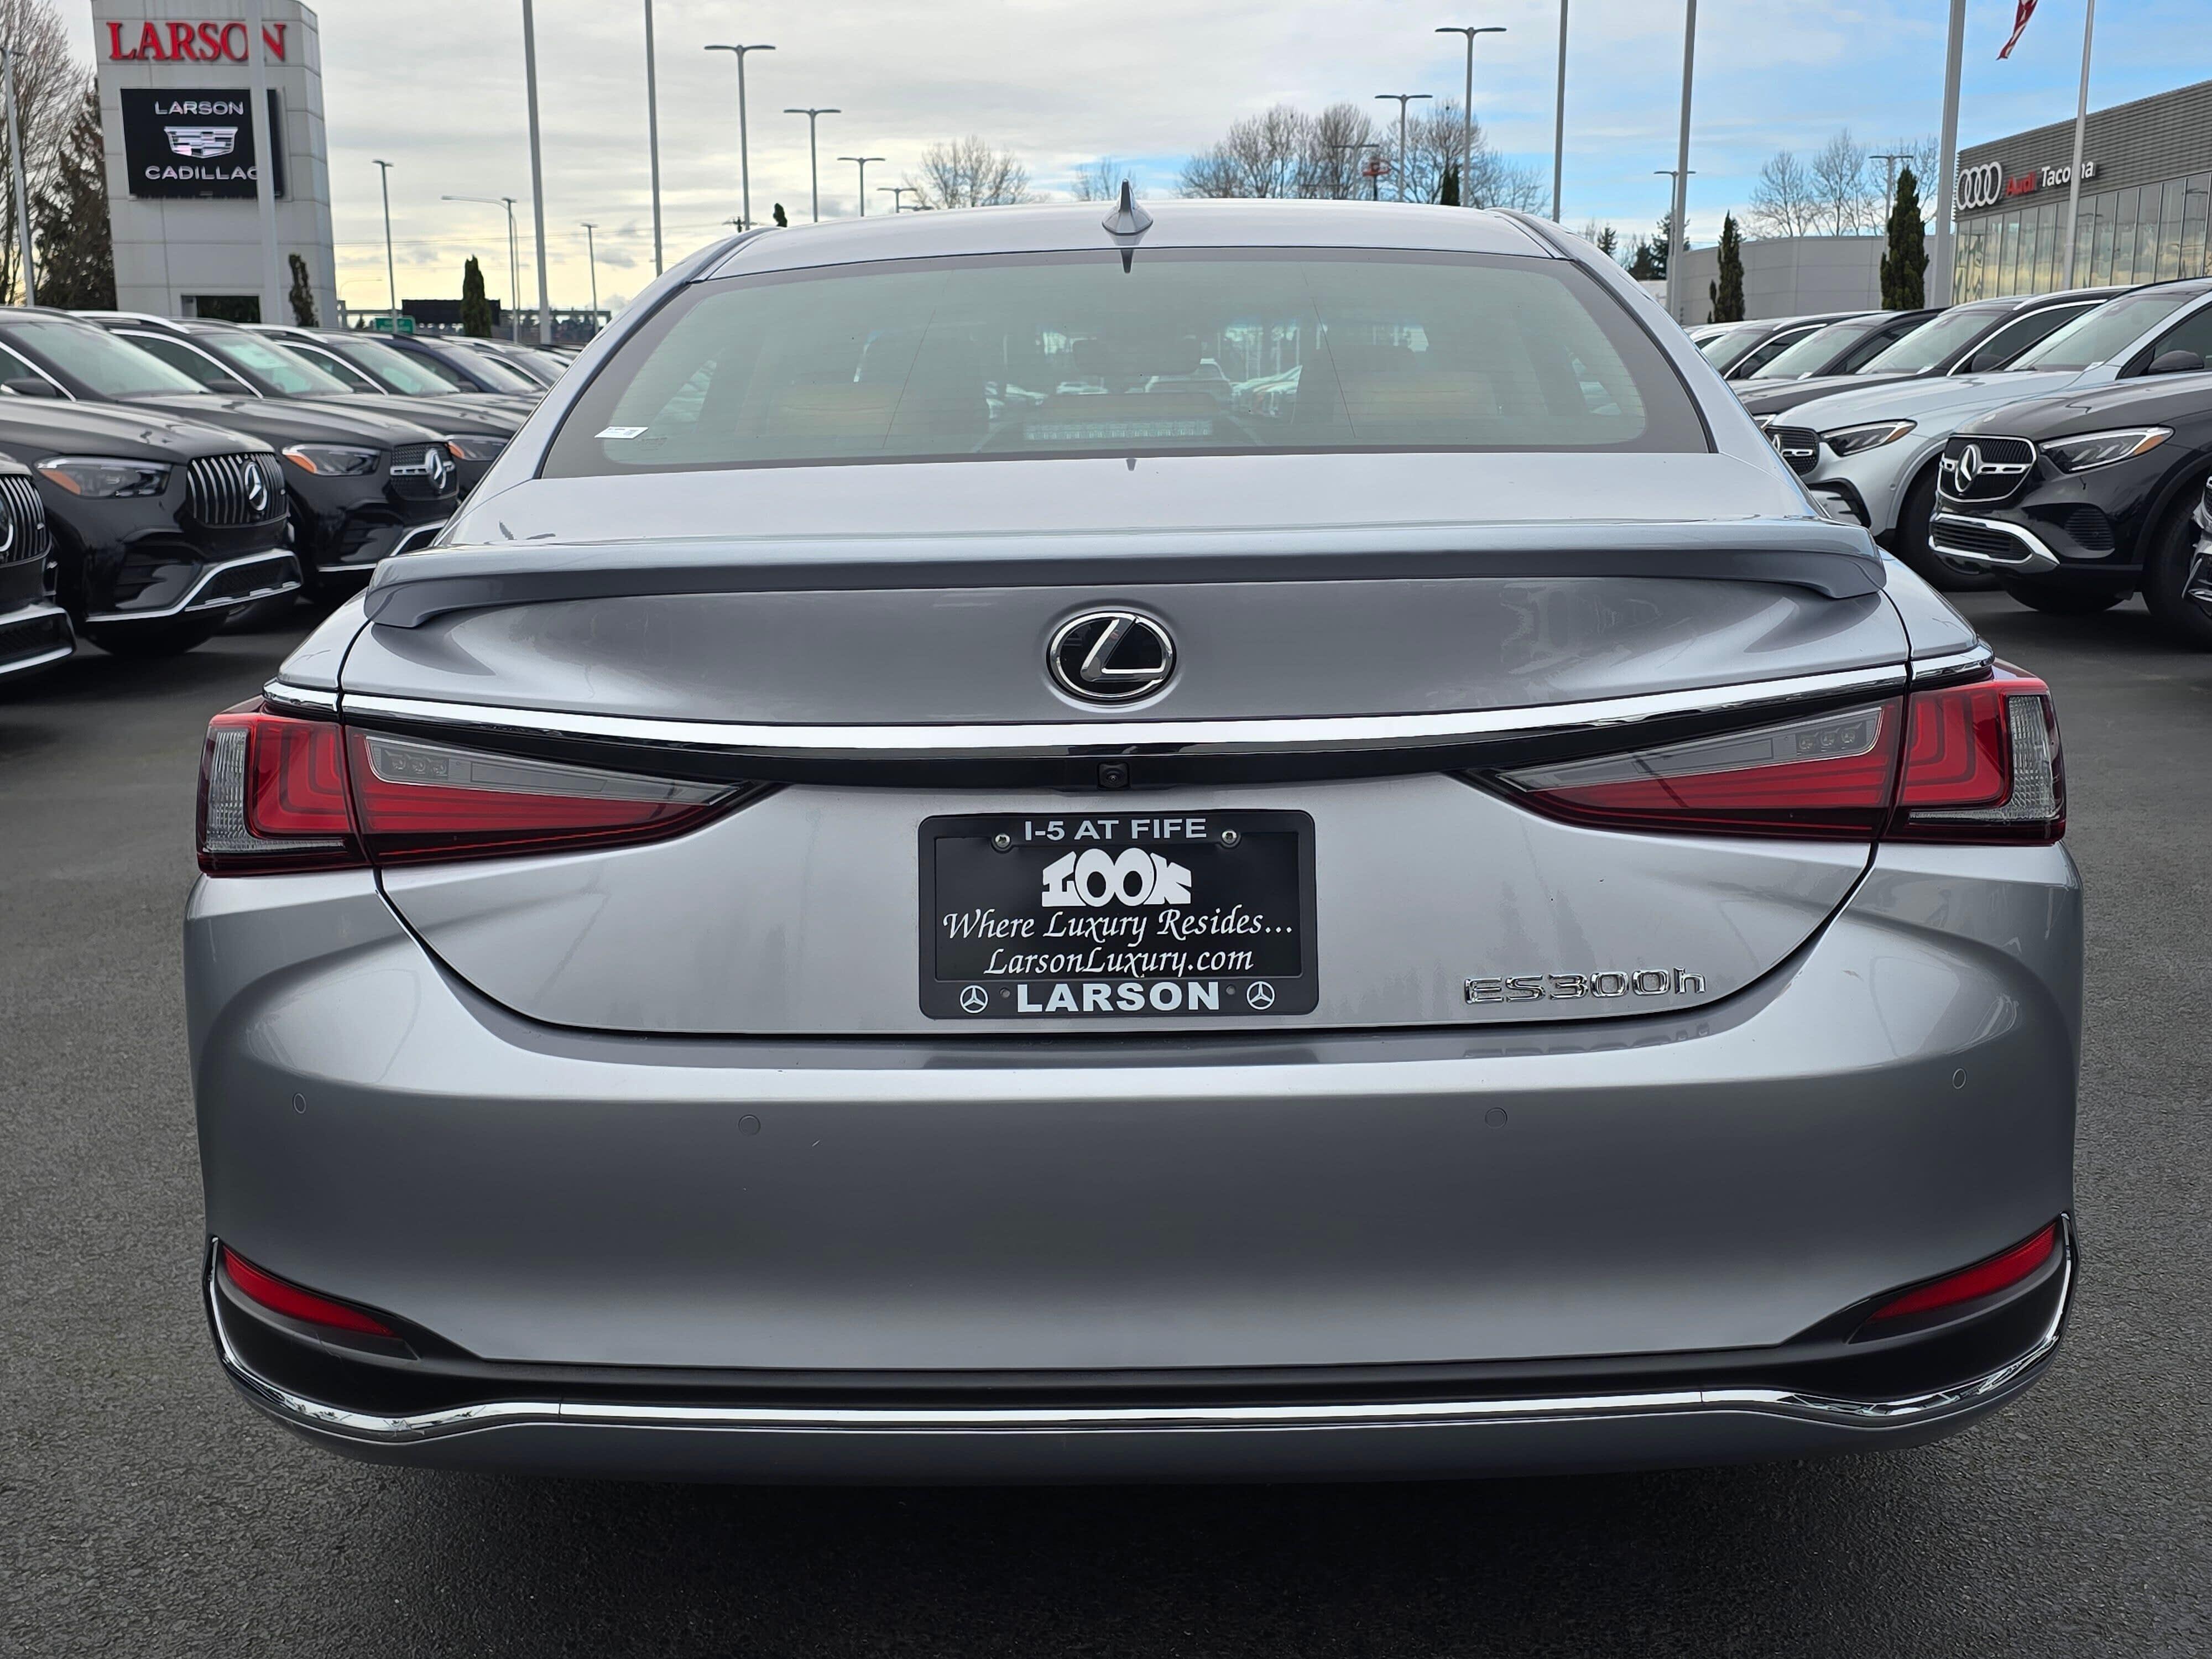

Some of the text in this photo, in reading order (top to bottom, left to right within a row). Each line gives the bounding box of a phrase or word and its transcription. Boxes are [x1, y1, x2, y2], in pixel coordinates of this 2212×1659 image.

[106, 21, 286, 62] LARSON
[155, 101, 244, 115] LARSON
[2006, 171, 2037, 196] Audi
[1025, 818, 1207, 841] I-5 AT FIFE
[943, 904, 1292, 947] Where Luxury Resides...
[983, 946, 1254, 978] LarsonLuxury.com
[1017, 981, 1219, 1013] LARSON
